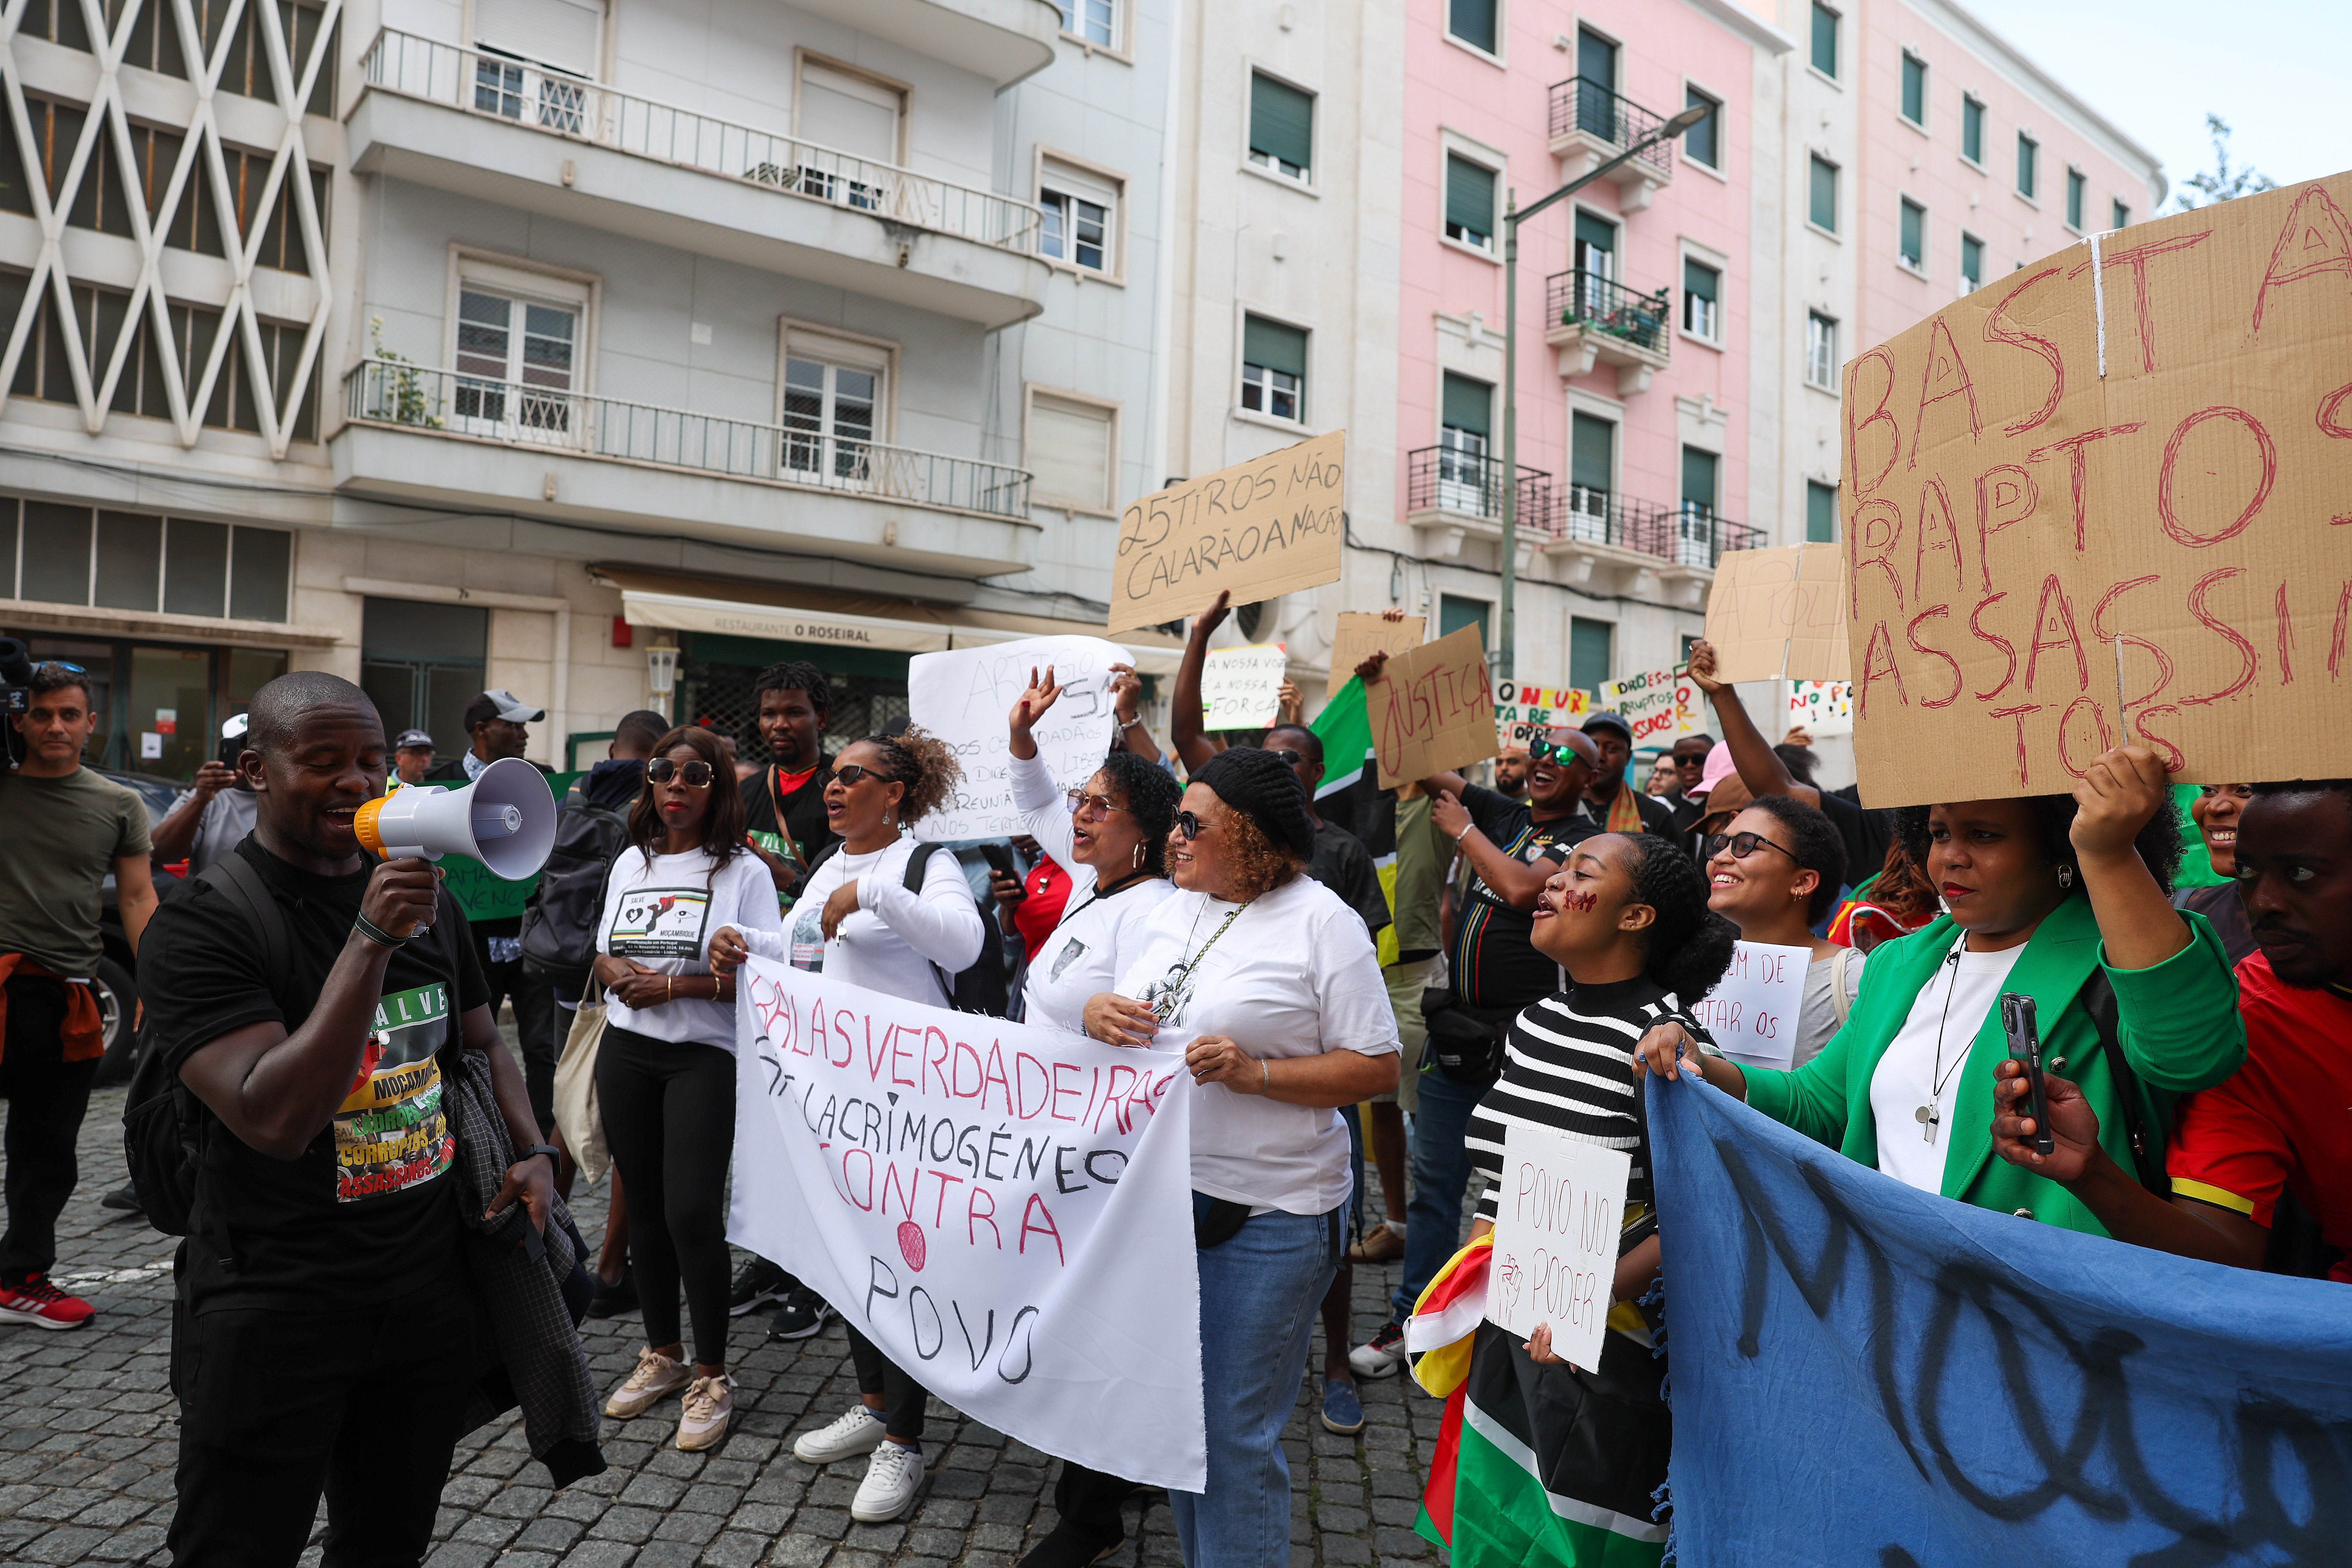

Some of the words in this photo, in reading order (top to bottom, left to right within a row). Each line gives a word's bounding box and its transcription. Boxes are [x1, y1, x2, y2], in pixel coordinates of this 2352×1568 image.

[1849, 183, 2352, 499] BASTA
[1286, 452, 1341, 497] NÃO
[714, 617, 792, 636] RESTAURANTE
[795, 624, 804, 637] O
[808, 625, 871, 642] ROSEIRAL
[1223, 657, 1258, 670] NOSSA
[1229, 679, 1268, 691] NOSSA
[1369, 662, 1494, 777] JUSTIÇA
[955, 789, 1012, 811] REUNIÃ
[660, 930, 696, 938] MOÇAMBIQUE
[1761, 954, 1788, 984] DE
[376, 987, 446, 1027] ALVE
[1691, 999, 1742, 1033] ATAR
[1756, 1011, 1779, 1038] OS
[1517, 1162, 1572, 1234] POVO
[1580, 1190, 1609, 1256] NO
[1532, 1248, 1596, 1335] PODER
[867, 1255, 1039, 1384] POVO
